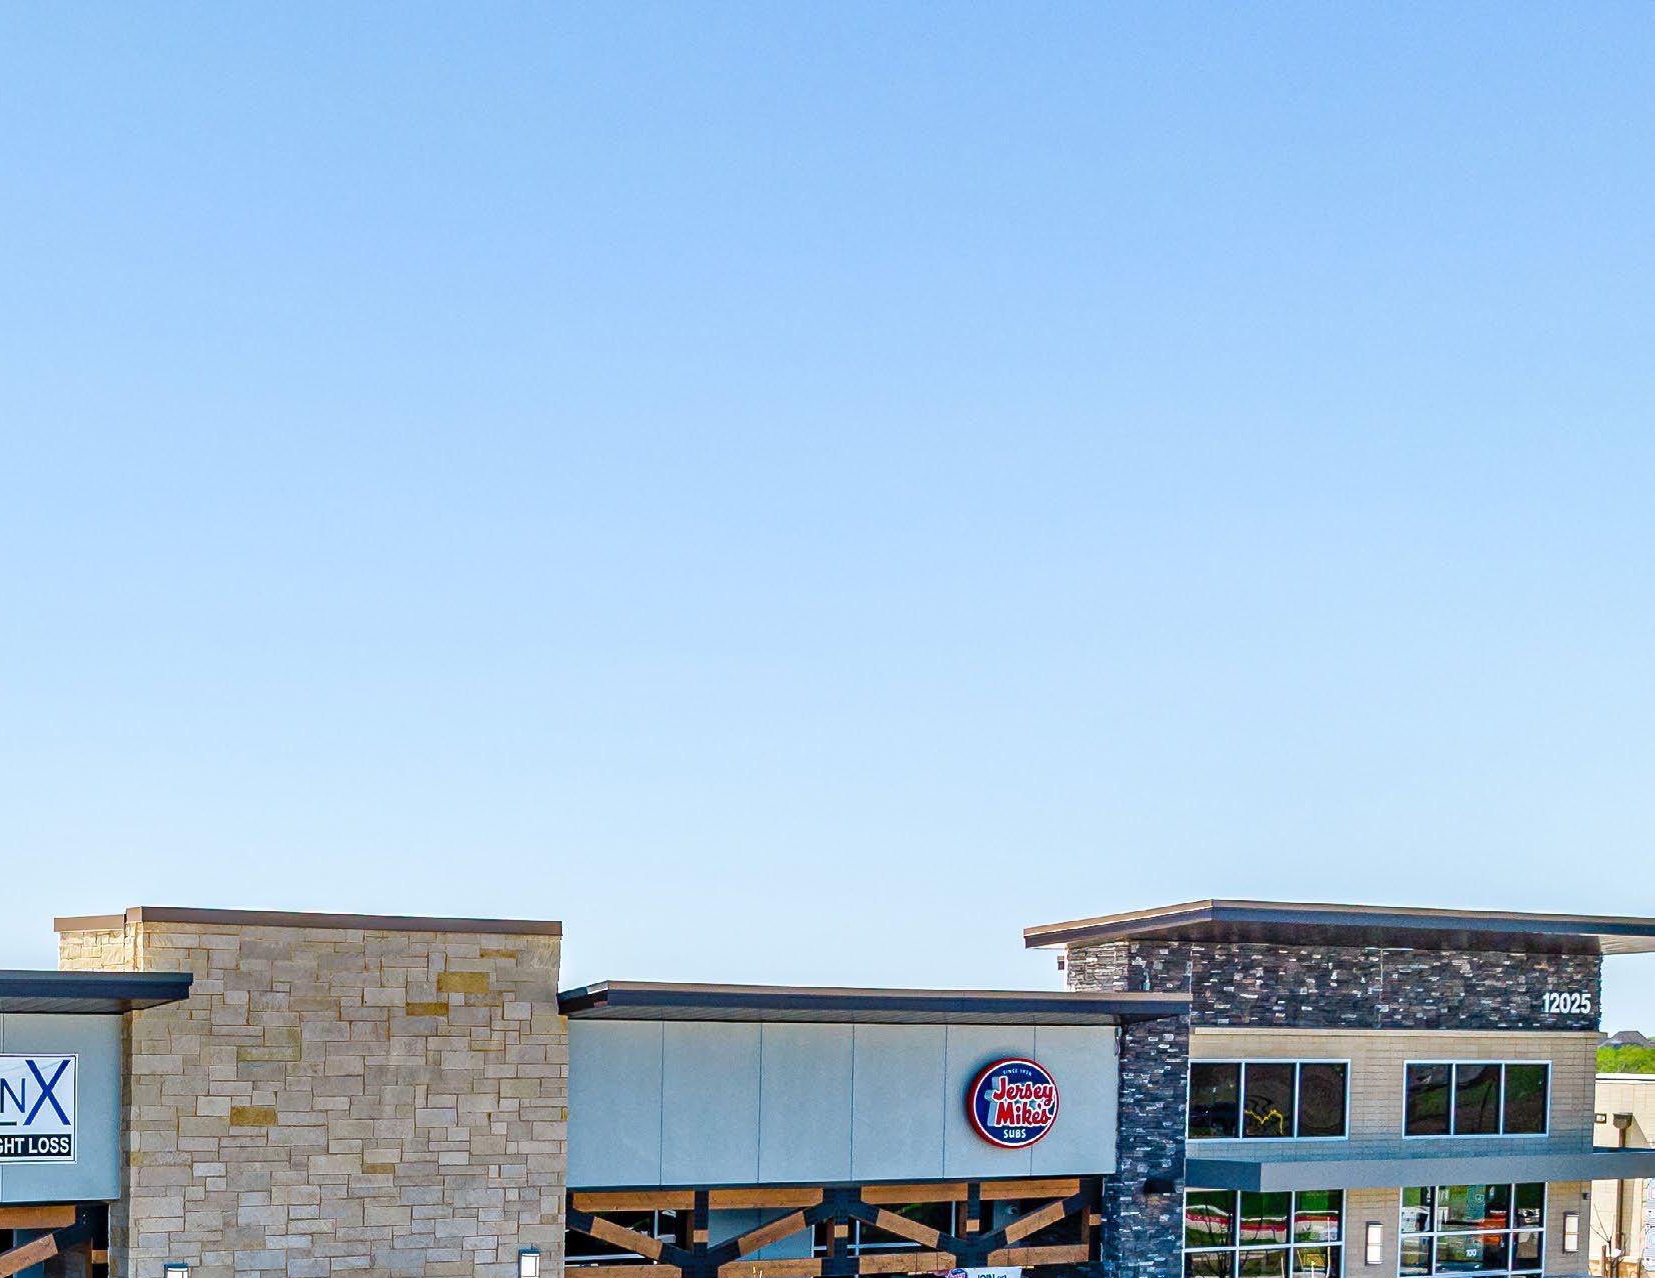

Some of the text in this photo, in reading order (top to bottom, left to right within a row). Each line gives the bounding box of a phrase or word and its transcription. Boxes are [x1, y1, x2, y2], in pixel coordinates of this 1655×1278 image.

[1543, 992, 1591, 1014] 12025
[992, 1076, 1055, 1107] Jersey
[995, 1101, 1052, 1127] Mike's
[1003, 1128, 1027, 1139] SUBS
[29, 1136, 70, 1154] LOSS
